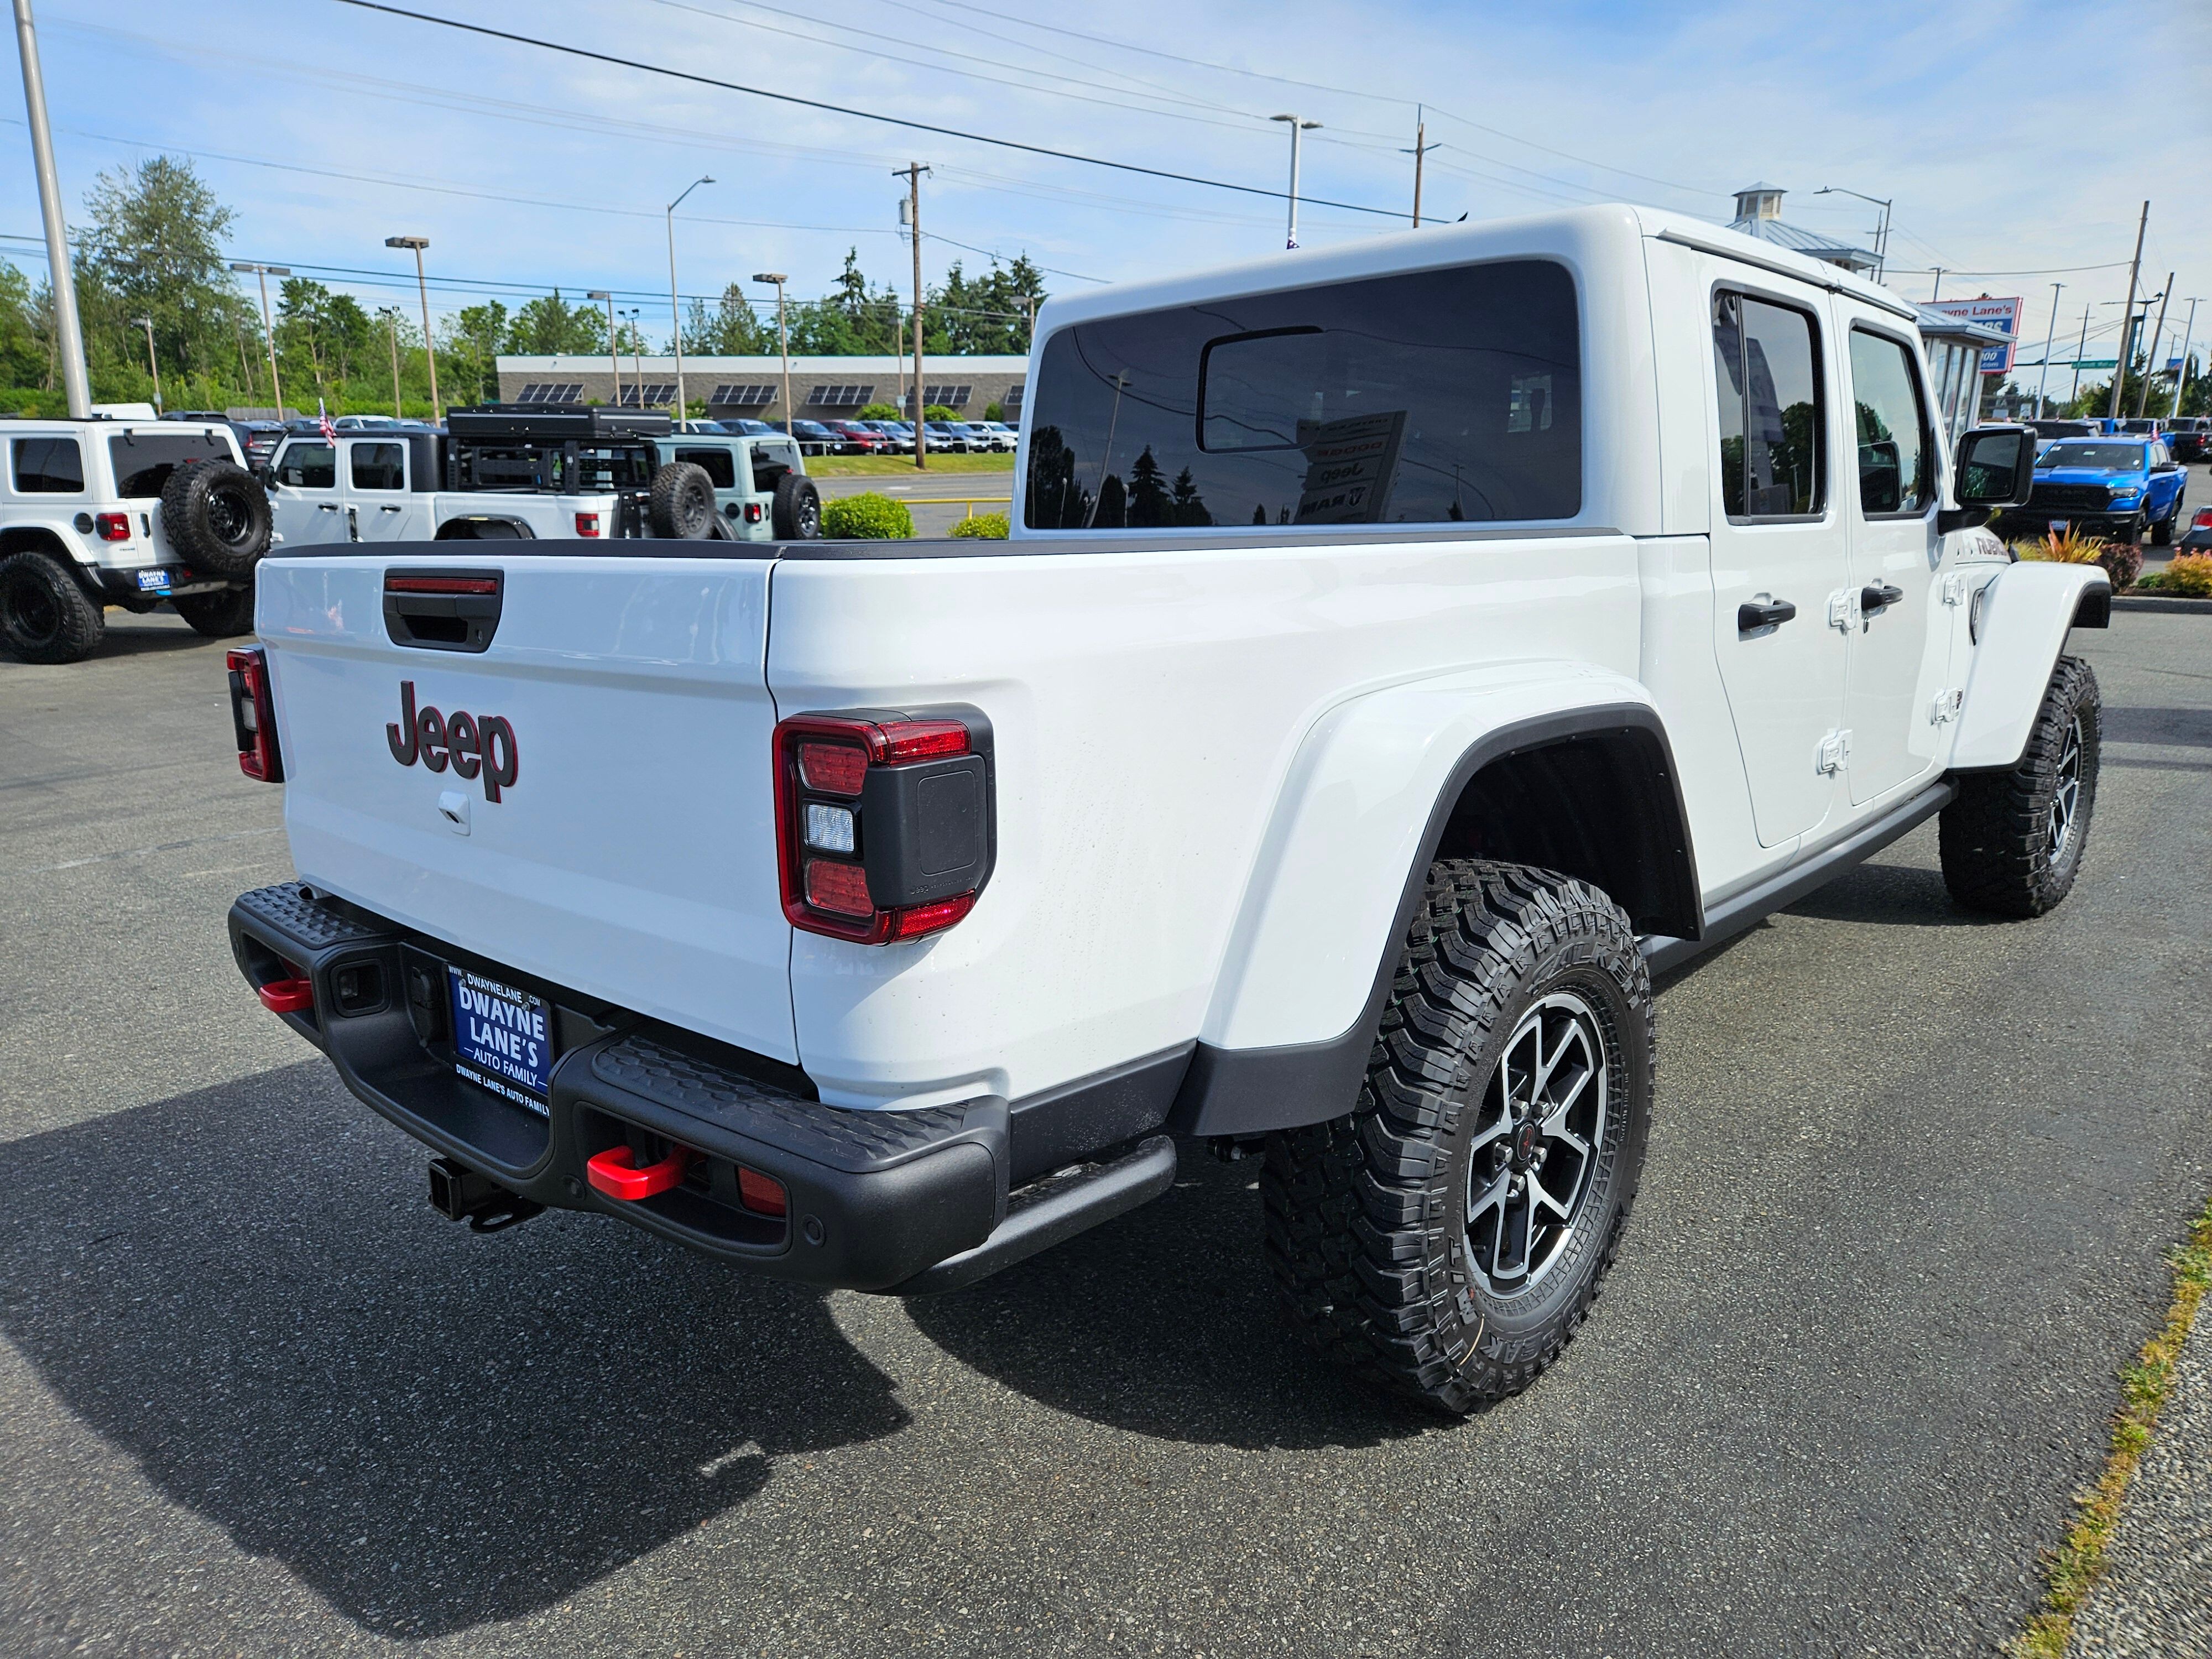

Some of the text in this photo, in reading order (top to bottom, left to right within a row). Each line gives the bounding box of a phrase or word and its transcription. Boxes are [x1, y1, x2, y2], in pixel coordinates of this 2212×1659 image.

[1973, 305, 2012, 316] Lane's
[1980, 352, 1997, 361] 00
[385, 680, 519, 804] Jeep
[467, 973, 523, 1004] DWAYNELANE
[1525, 941, 1641, 1011] FALKEN
[458, 985, 545, 1042] DWAYNE
[470, 1016, 539, 1068] LANE'S
[473, 1047, 538, 1087] AUTO FAMILY
[456, 1063, 550, 1117] DWAYNE LANE'S AUTO FAMILY
